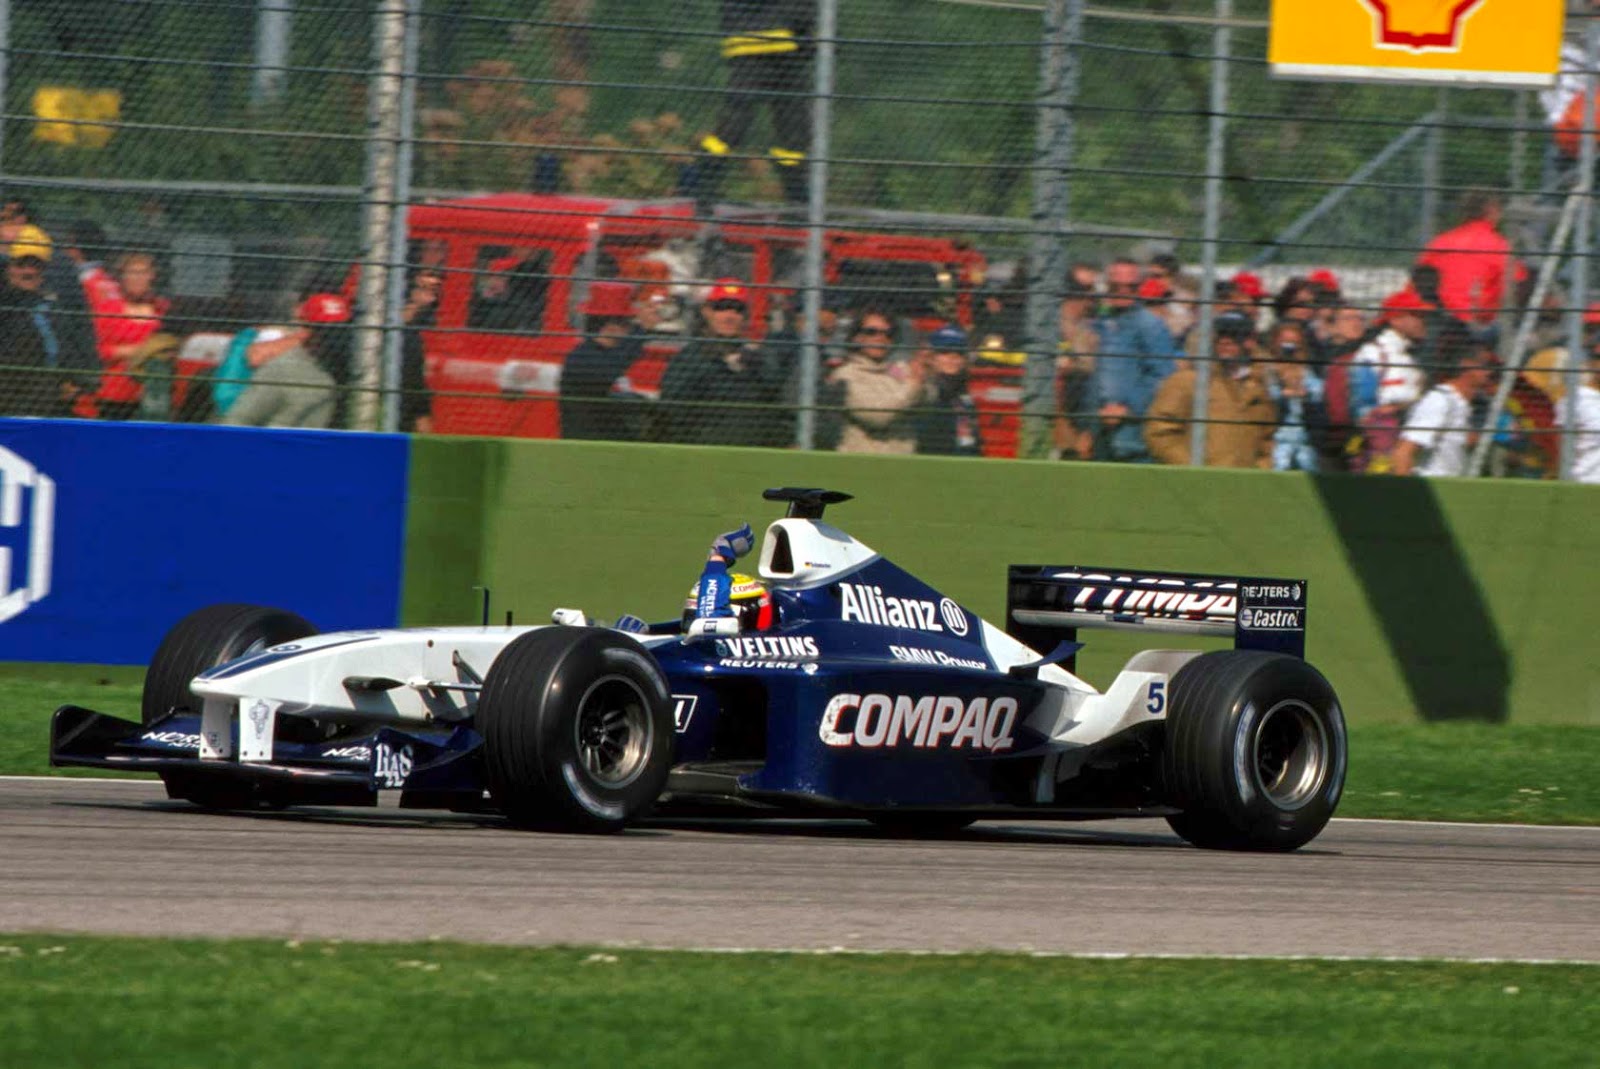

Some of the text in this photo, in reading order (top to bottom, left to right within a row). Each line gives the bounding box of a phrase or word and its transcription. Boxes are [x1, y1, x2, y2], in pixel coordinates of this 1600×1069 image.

[1241, 586, 1290, 598] REUTERS
[838, 582, 944, 632] Allianz
[1253, 609, 1300, 627] Castrol
[725, 636, 819, 657] VELTINS
[719, 658, 799, 670] REUTERS
[1147, 682, 1164, 714] 5
[819, 693, 1018, 753] COMPAQ
